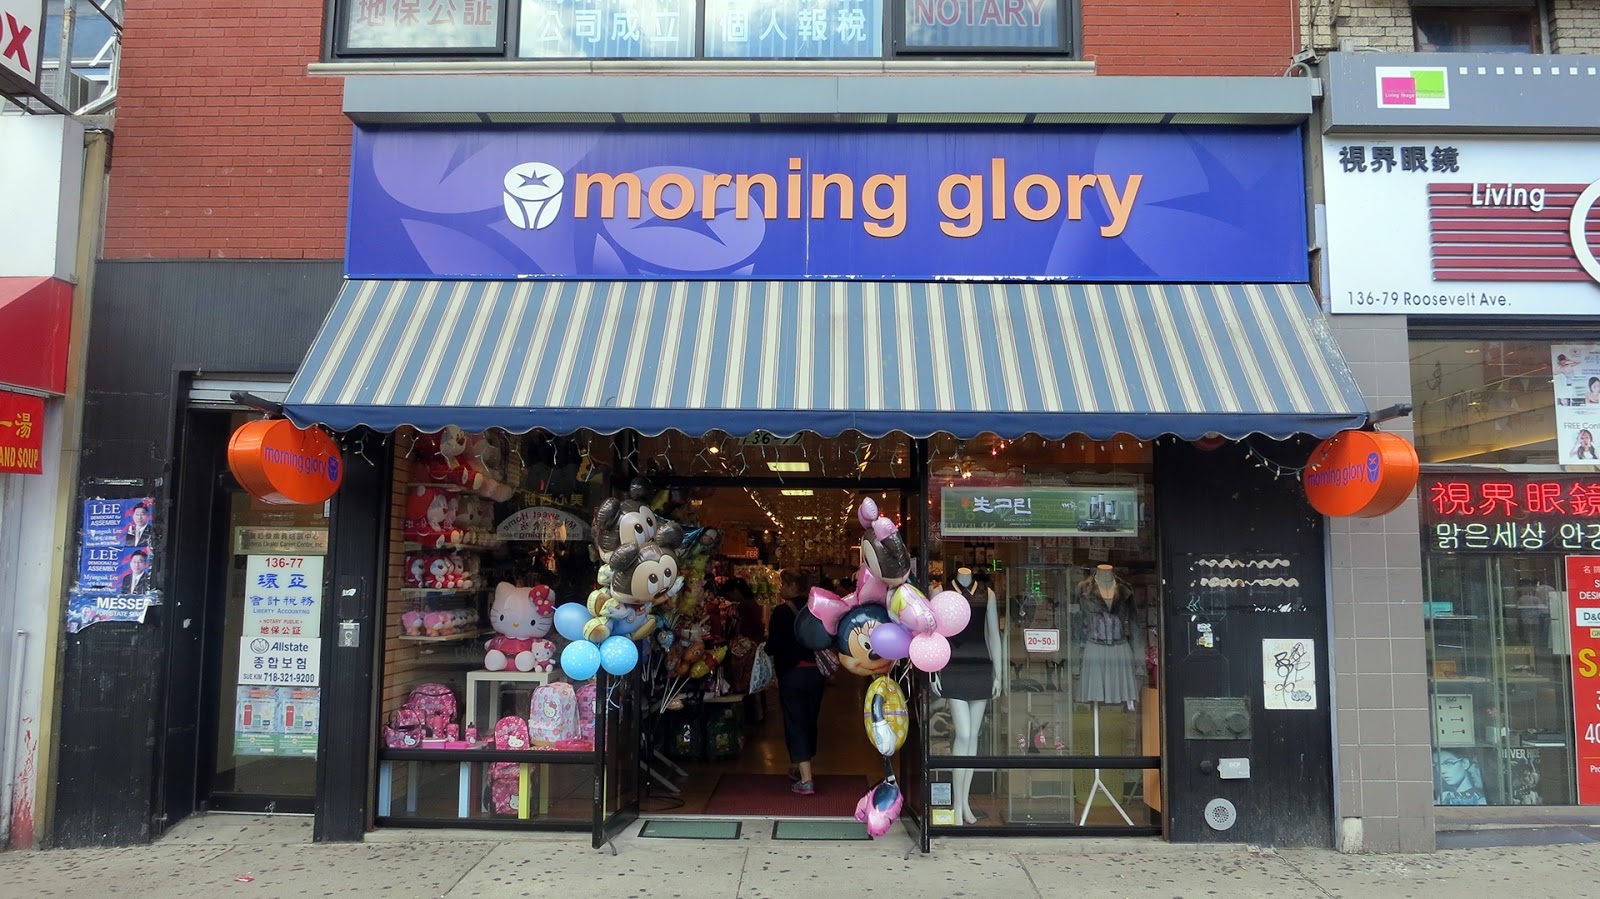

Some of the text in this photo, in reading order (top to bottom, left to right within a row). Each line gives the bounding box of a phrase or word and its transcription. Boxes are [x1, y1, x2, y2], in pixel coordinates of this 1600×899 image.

[914, 0, 1045, 26] NOTARY
[1339, 145, 1460, 173] 視界眼鏡
[573, 157, 1143, 239] morning glory
[1471, 182, 1546, 212] Living
[1348, 291, 1512, 306] 136-79 Roosevelt Ave.
[17, 447, 39, 469] SOUP
[264, 447, 329, 478] morning glory
[1307, 462, 1366, 487] morning glory
[92, 503, 121, 515] LEE
[1431, 482, 1600, 517] 視界眼鏡
[90, 519, 121, 527] ASSEMBLY
[1436, 521, 1547, 550] 맑은세상
[90, 548, 119, 561] LEE
[265, 558, 304, 569] 136-77
[270, 642, 309, 652] Allstate
[264, 672, 315, 683] 718-321-9200
